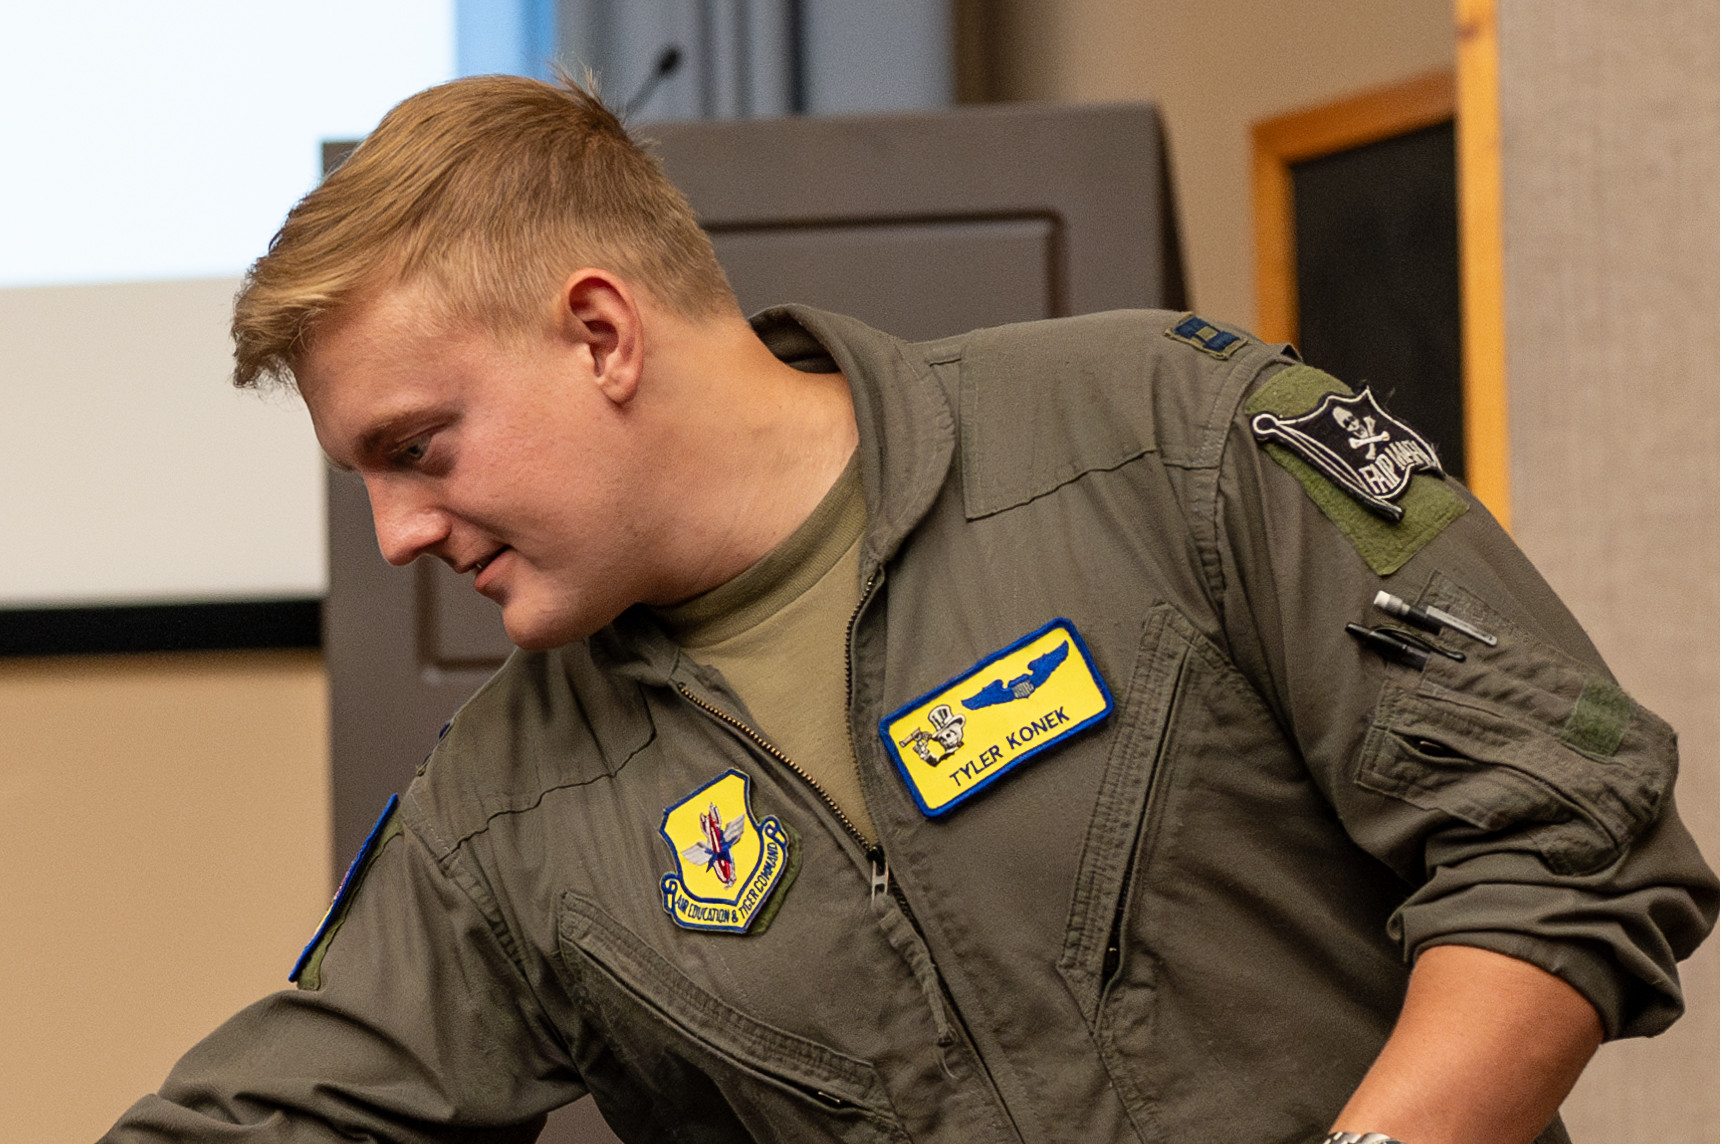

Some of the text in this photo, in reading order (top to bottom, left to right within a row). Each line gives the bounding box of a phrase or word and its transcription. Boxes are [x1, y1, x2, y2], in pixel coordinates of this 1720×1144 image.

[949, 706, 1070, 787] TYLER KONEK
[676, 894, 687, 915] AIR
[688, 904, 730, 923] EDUCATION
[731, 910, 738, 923] &
[754, 842, 779, 893] COMMAND
